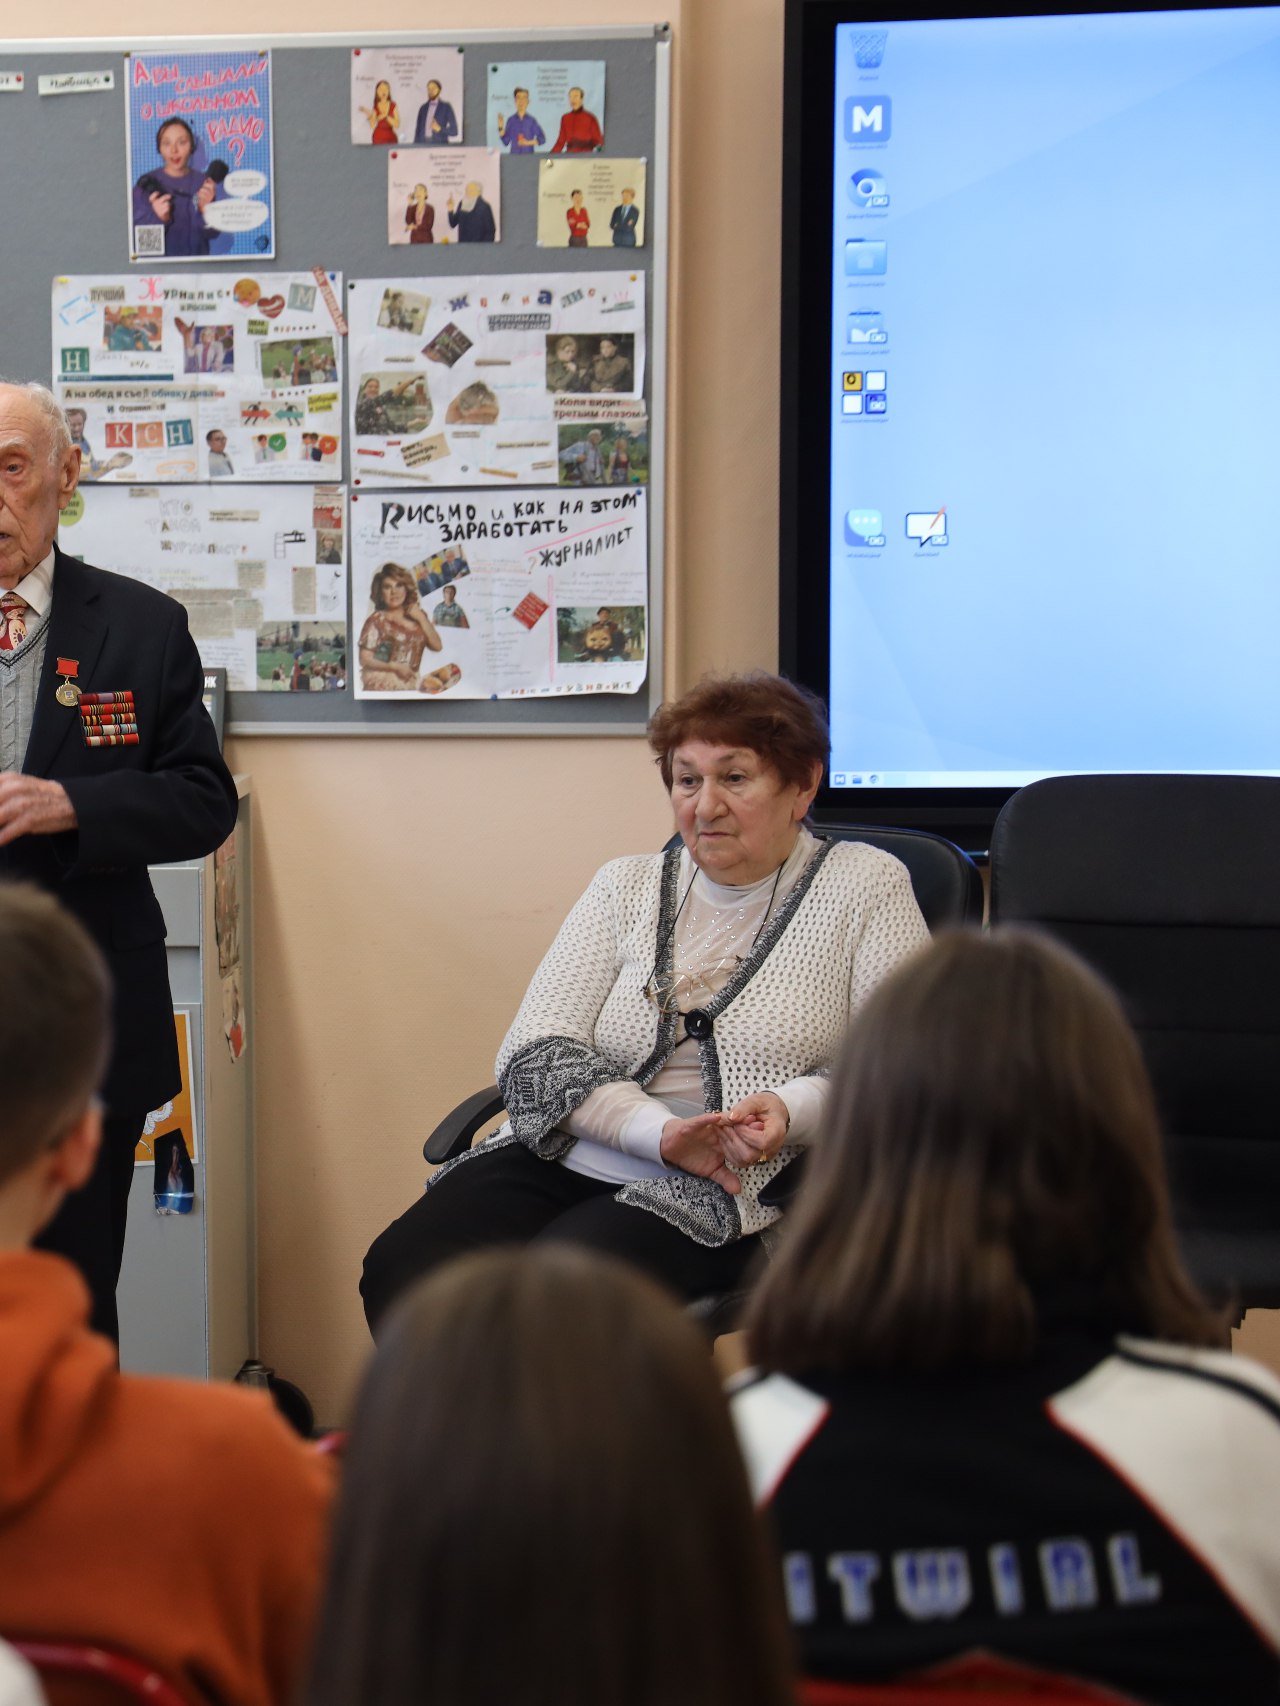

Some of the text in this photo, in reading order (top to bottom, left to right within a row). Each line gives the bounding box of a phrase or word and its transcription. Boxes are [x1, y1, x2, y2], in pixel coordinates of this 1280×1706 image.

[134, 60, 268, 93] А ВЫ СЛЫШАЛИ
[140, 88, 260, 120] О ШКОЛЬНОМ
[207, 115, 265, 144] РАДИО
[65, 389, 72, 398] А
[74, 390, 87, 398] на
[89, 388, 114, 400] обед
[151, 388, 187, 400] обивку
[554, 410, 599, 420] третьим
[380, 502, 477, 536] ПИСЬМО
[559, 500, 584, 515] НА
[439, 519, 569, 543] ЗАРАБОТАТЬ
[538, 526, 635, 567] ЖУРНАЛИСТ
